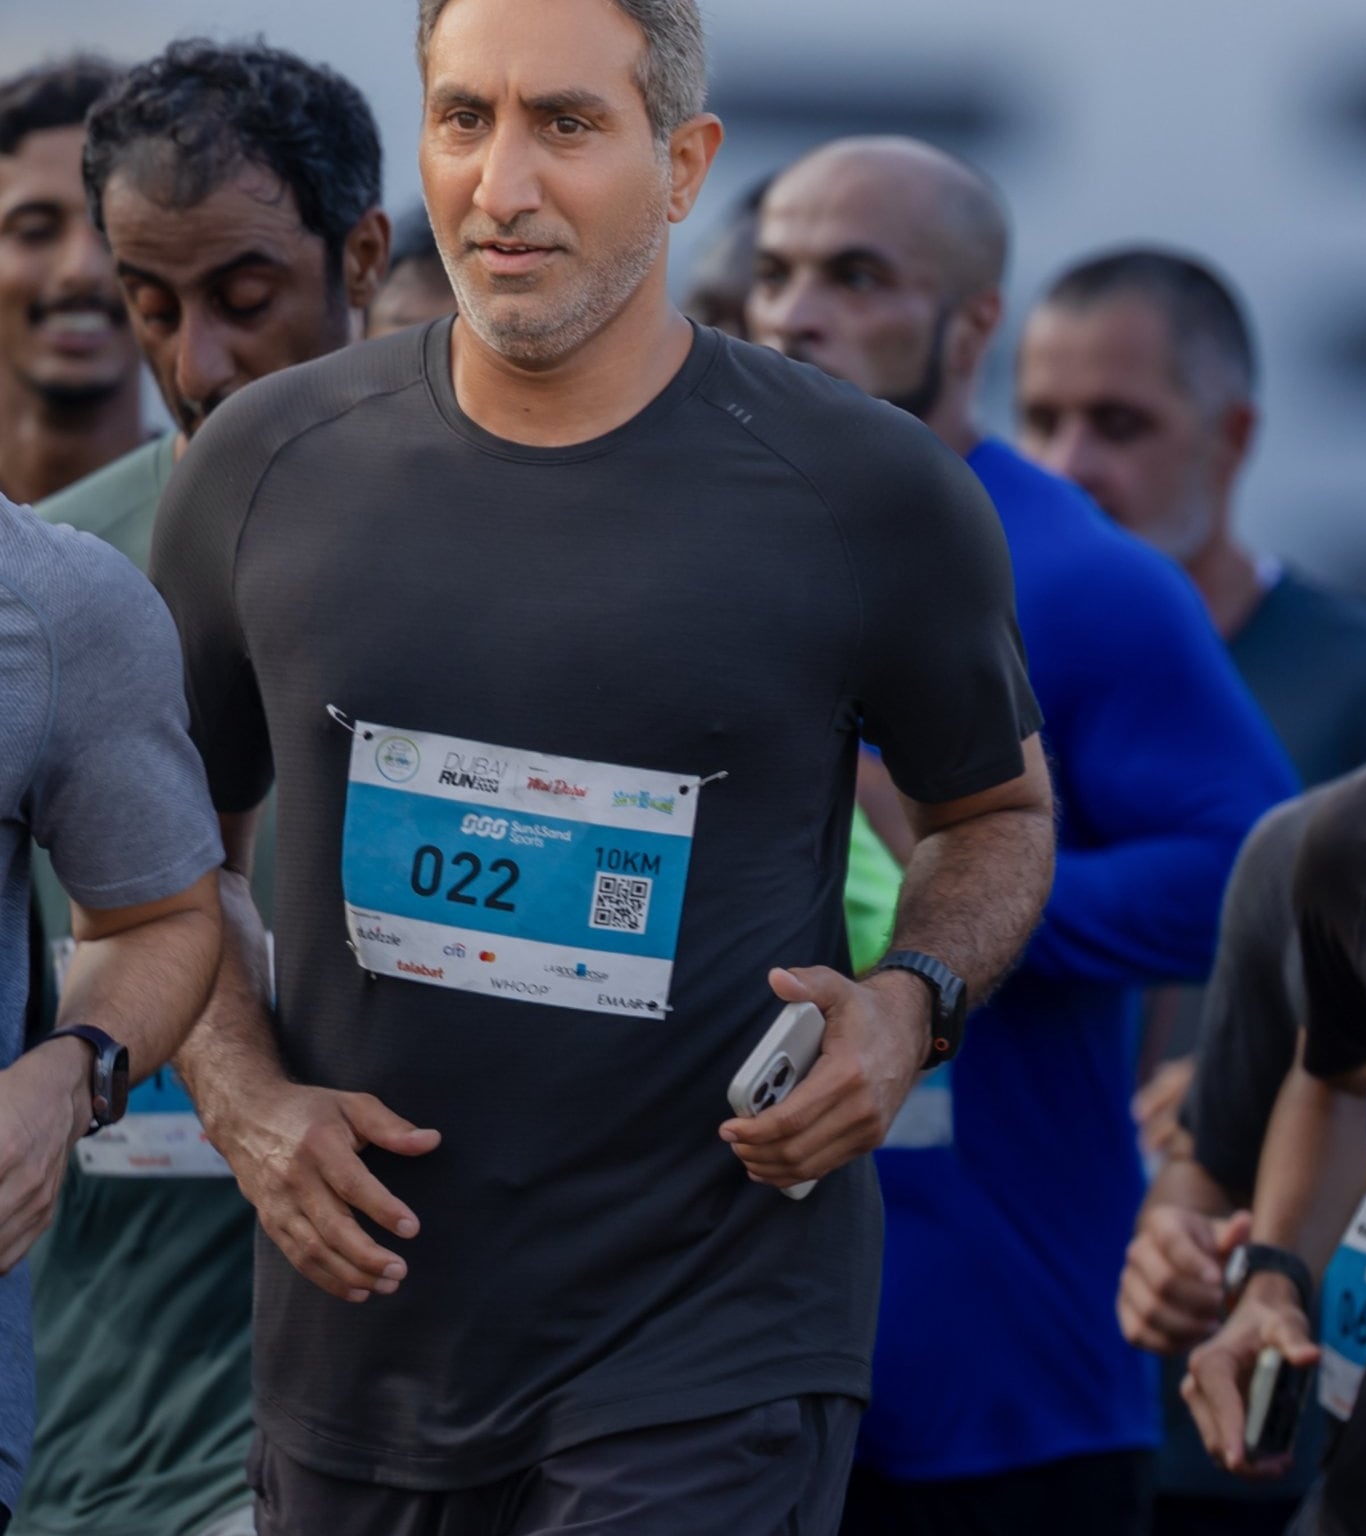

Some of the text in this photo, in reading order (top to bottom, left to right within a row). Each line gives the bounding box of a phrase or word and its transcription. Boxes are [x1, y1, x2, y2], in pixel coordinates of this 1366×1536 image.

[444, 751, 508, 779] DUBAI
[438, 769, 476, 789] RUN
[509, 831, 545, 848] Sports
[510, 820, 572, 842] Sun&Sand
[595, 847, 662, 875] 10KM
[411, 844, 521, 913] 022
[396, 960, 445, 980] talabat
[490, 977, 550, 996] WHOOP
